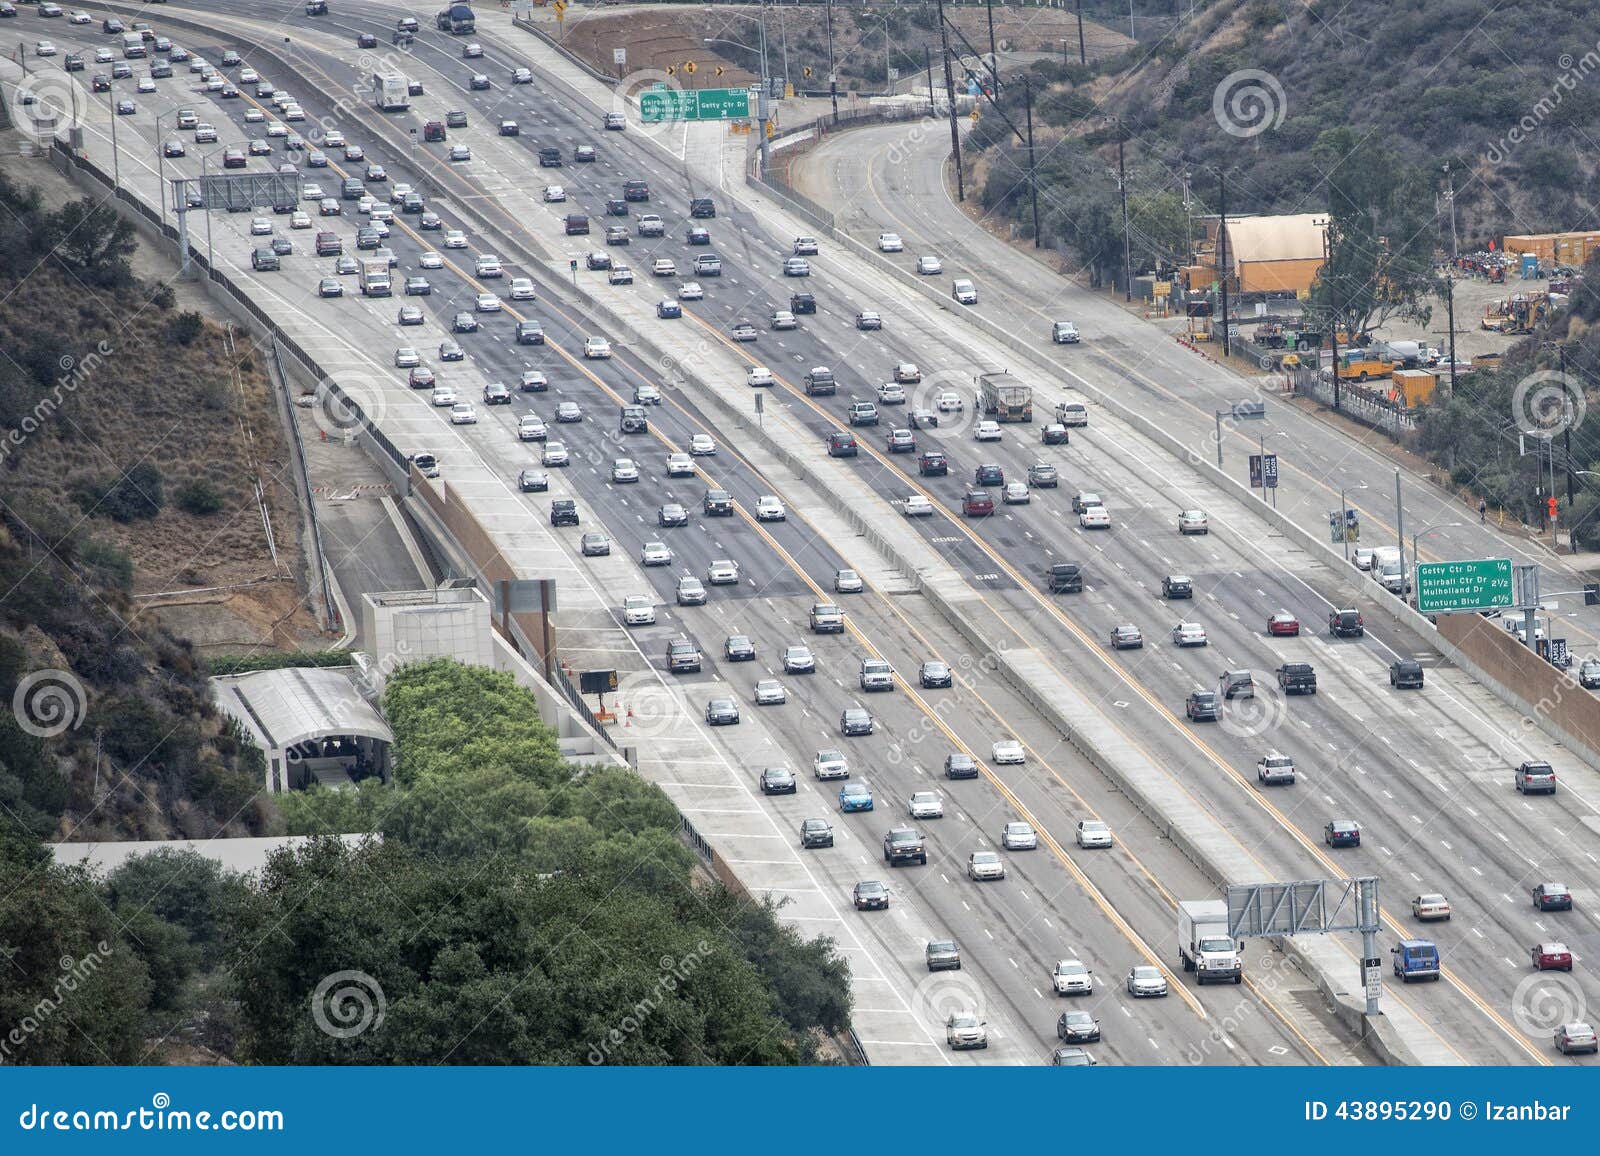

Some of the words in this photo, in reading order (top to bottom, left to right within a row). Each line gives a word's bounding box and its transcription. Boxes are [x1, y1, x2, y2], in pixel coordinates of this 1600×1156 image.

[1422, 566, 1446, 575] Getty
[1449, 565, 1462, 573] Ctr
[1466, 564, 1477, 572] Dr
[1423, 578, 1456, 586] Skirball
[1423, 586, 1470, 596] Mulholland
[1473, 585, 1484, 593] Dr
[1461, 597, 1480, 605] Blvd
